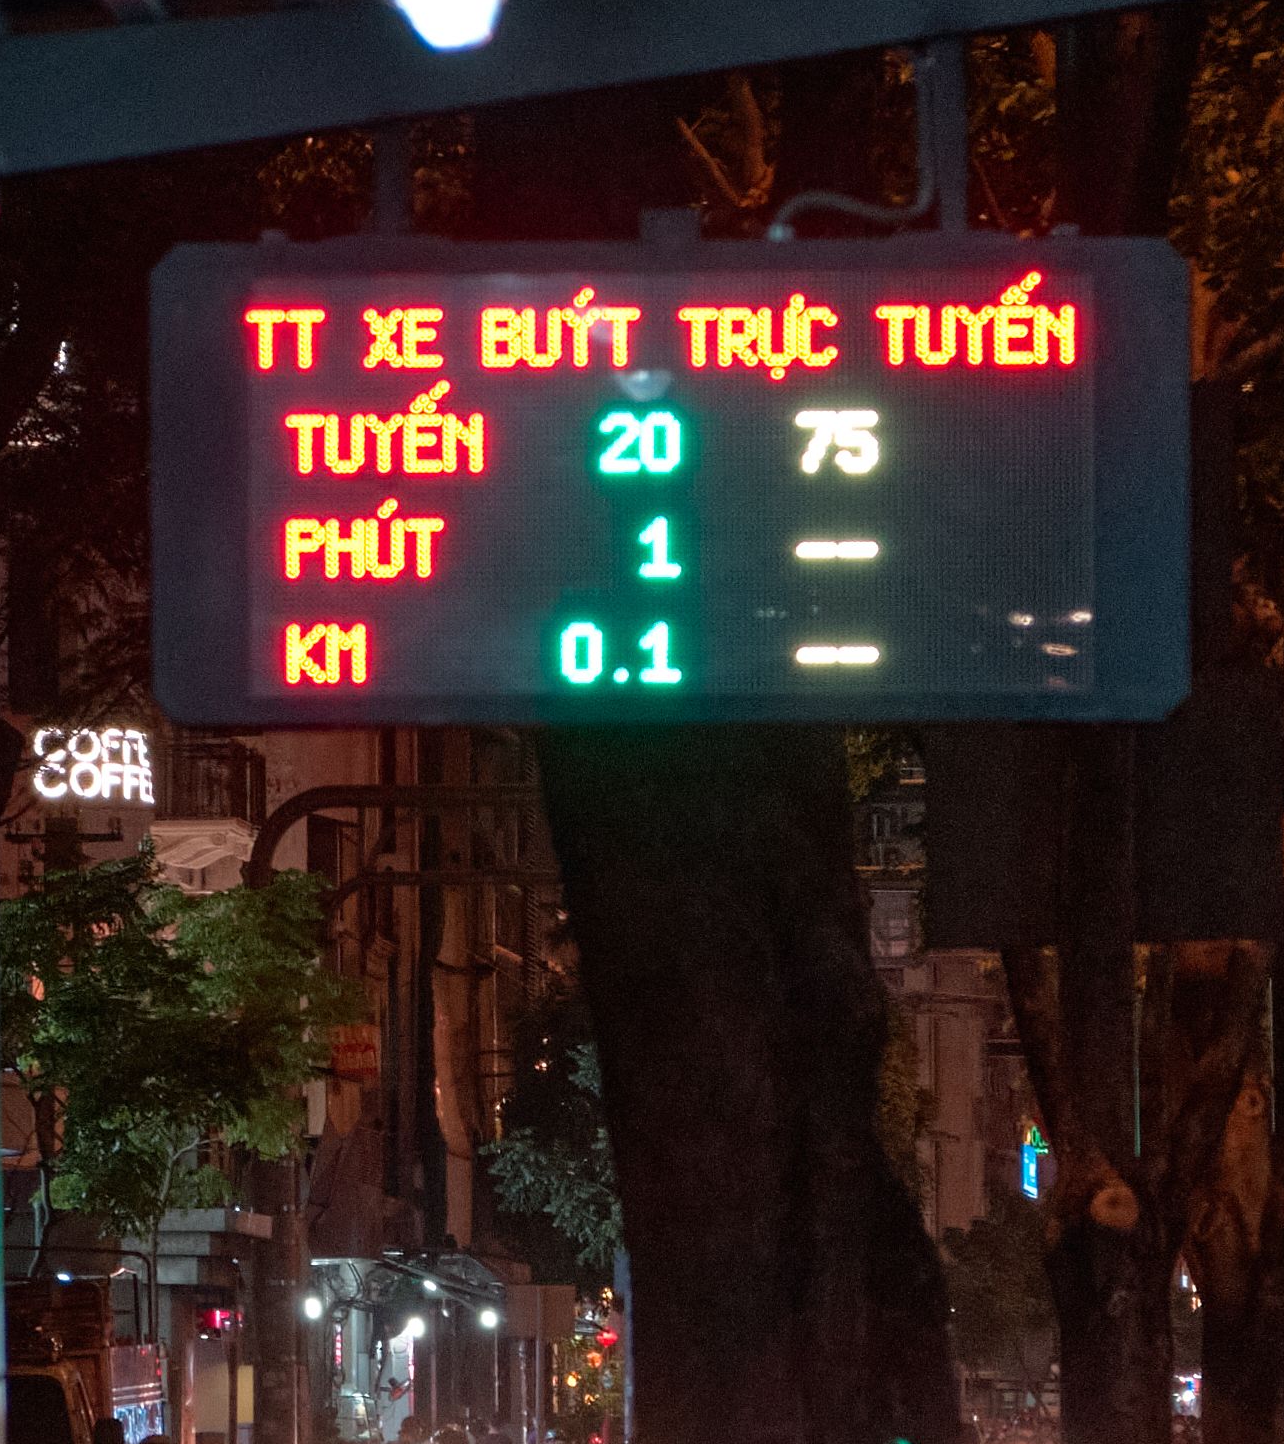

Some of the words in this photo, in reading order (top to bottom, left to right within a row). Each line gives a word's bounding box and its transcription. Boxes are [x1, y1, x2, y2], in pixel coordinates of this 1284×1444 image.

[244, 304, 328, 372] TT
[361, 304, 446, 372] XE
[477, 285, 646, 374] BUÝT
[676, 291, 838, 382] TRỰC
[872, 270, 1079, 368] TUYẾN
[282, 380, 490, 480] TUYẾN
[598, 410, 683, 476] 20
[795, 409, 879, 474] 75
[280, 496, 446, 584] PHÚT
[637, 516, 682, 581] 1
[280, 620, 372, 688] KM
[559, 621, 682, 686] 0.1
